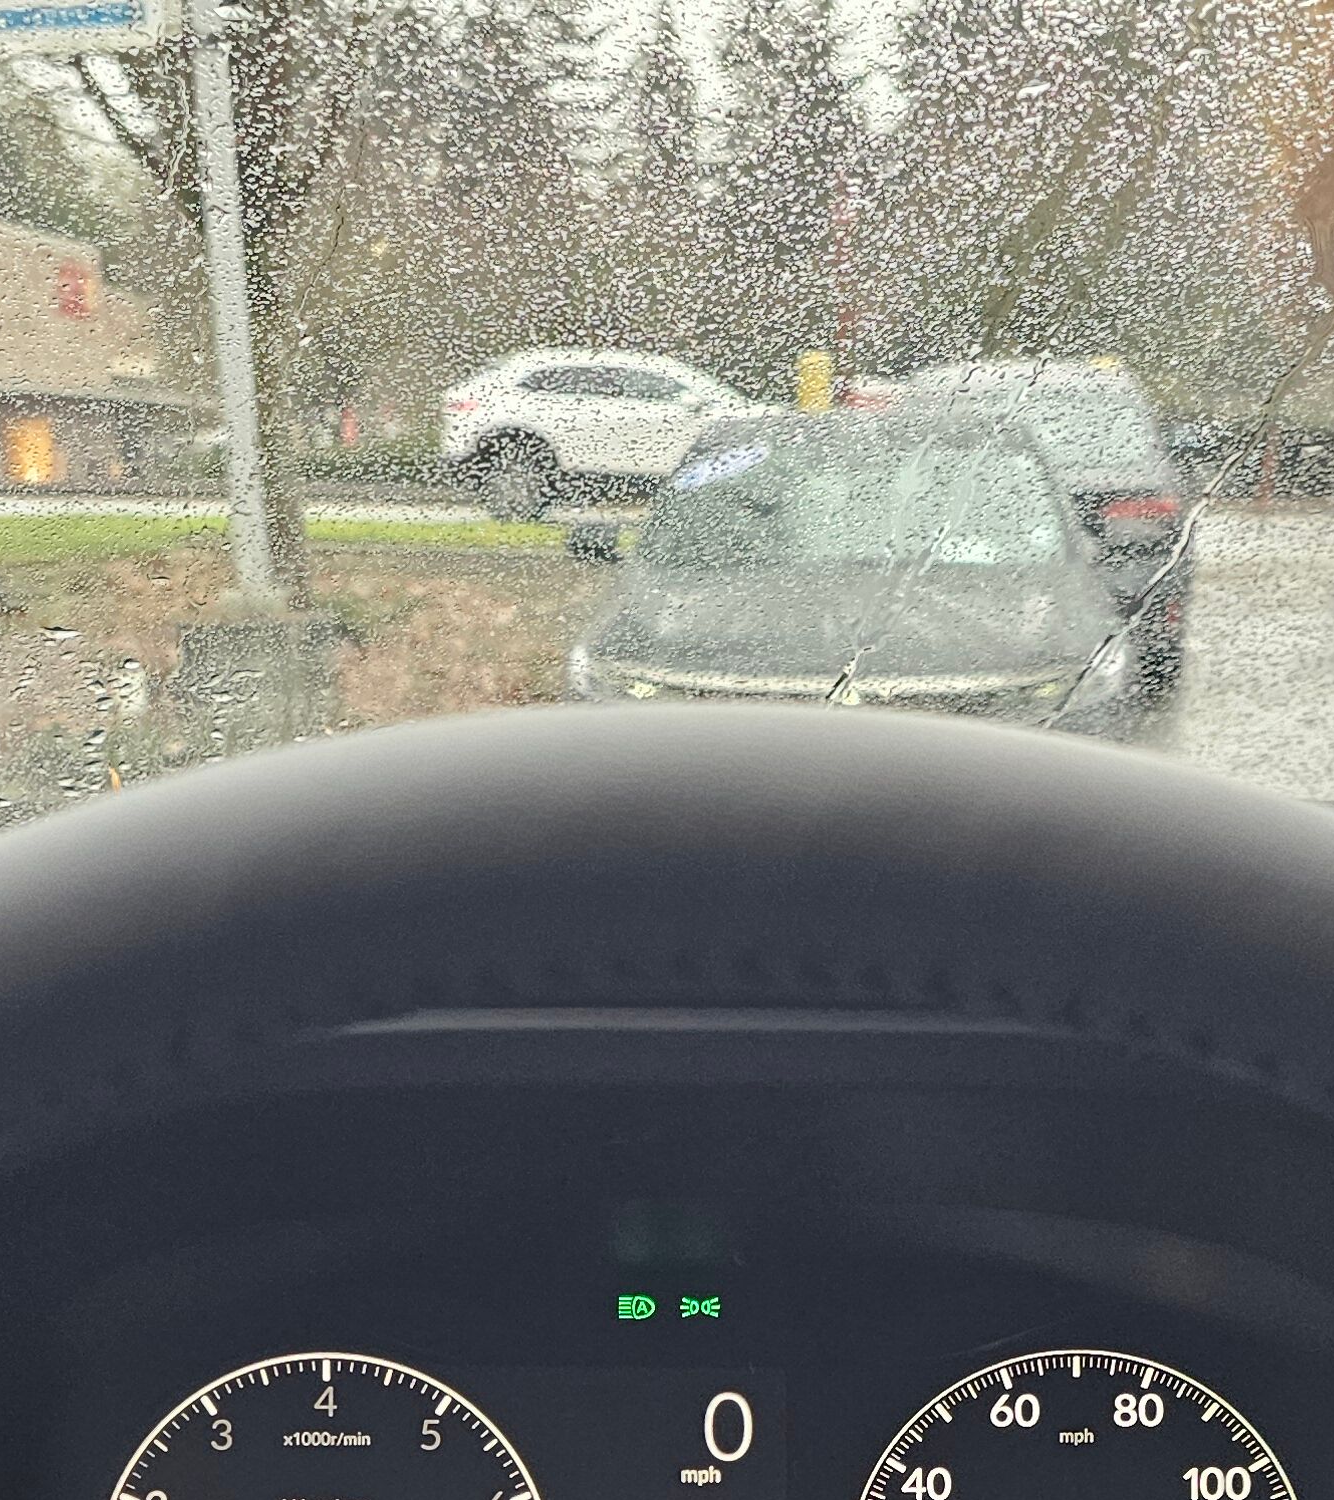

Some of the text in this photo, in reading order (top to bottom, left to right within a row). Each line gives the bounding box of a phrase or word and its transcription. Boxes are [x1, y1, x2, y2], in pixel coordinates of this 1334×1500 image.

[314, 1388, 337, 1417] 4
[990, 1395, 1040, 1428] 60
[1114, 1395, 1164, 1428] 80
[211, 1420, 233, 1451] 3
[283, 1432, 371, 1446] x1000r/min
[421, 1420, 441, 1450] 5
[704, 1391, 753, 1462] 0
[1059, 1429, 1095, 1446] mph
[680, 1465, 721, 1486] mph
[901, 1468, 952, 1500] 40
[1183, 1468, 1251, 1500] 100
